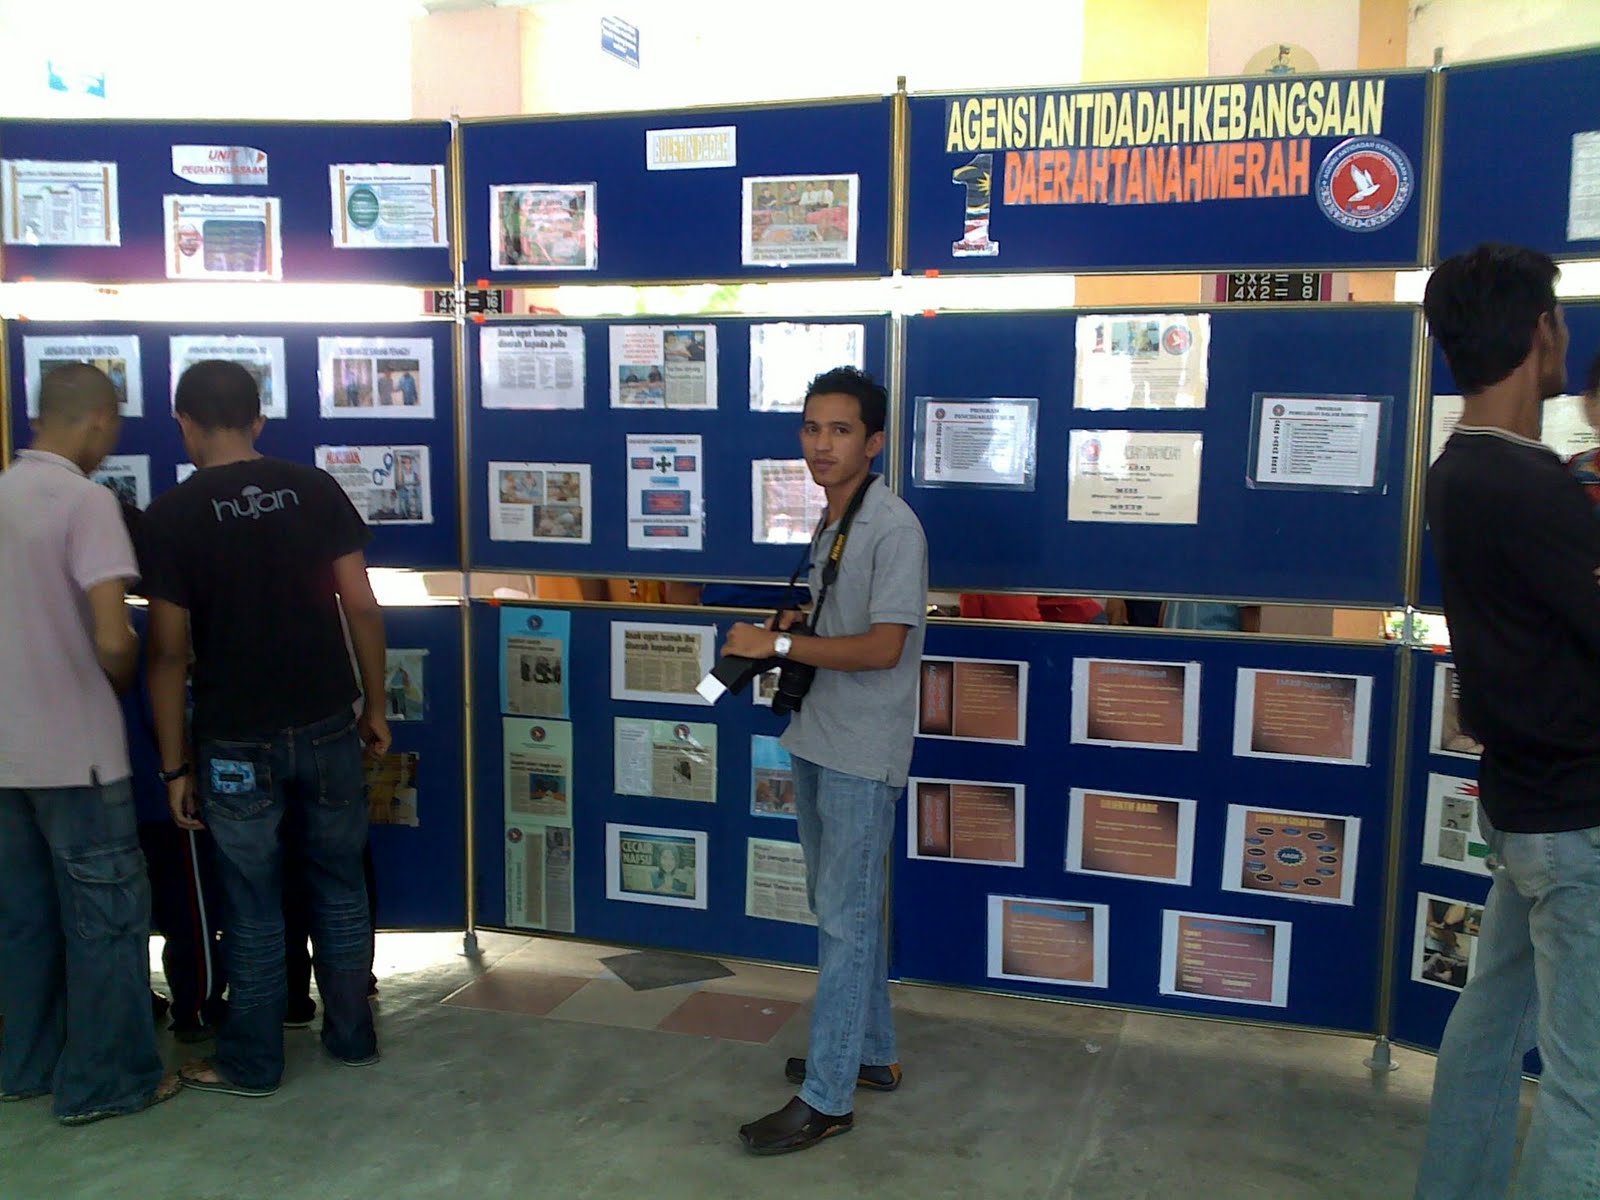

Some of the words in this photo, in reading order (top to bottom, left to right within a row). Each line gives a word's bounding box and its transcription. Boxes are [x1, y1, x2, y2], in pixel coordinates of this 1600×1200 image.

[947, 95, 1037, 153] AGENSI
[1038, 86, 1191, 148] ANTIDADAH
[1193, 79, 1386, 143] KEBANGSAAN
[208, 149, 239, 161] UNIT
[1003, 146, 1109, 205] DAERAH
[1110, 145, 1200, 205] TANAH
[1200, 138, 1312, 200] MERAH
[1302, 285, 1313, 299] 8
[210, 485, 300, 522] hujan
